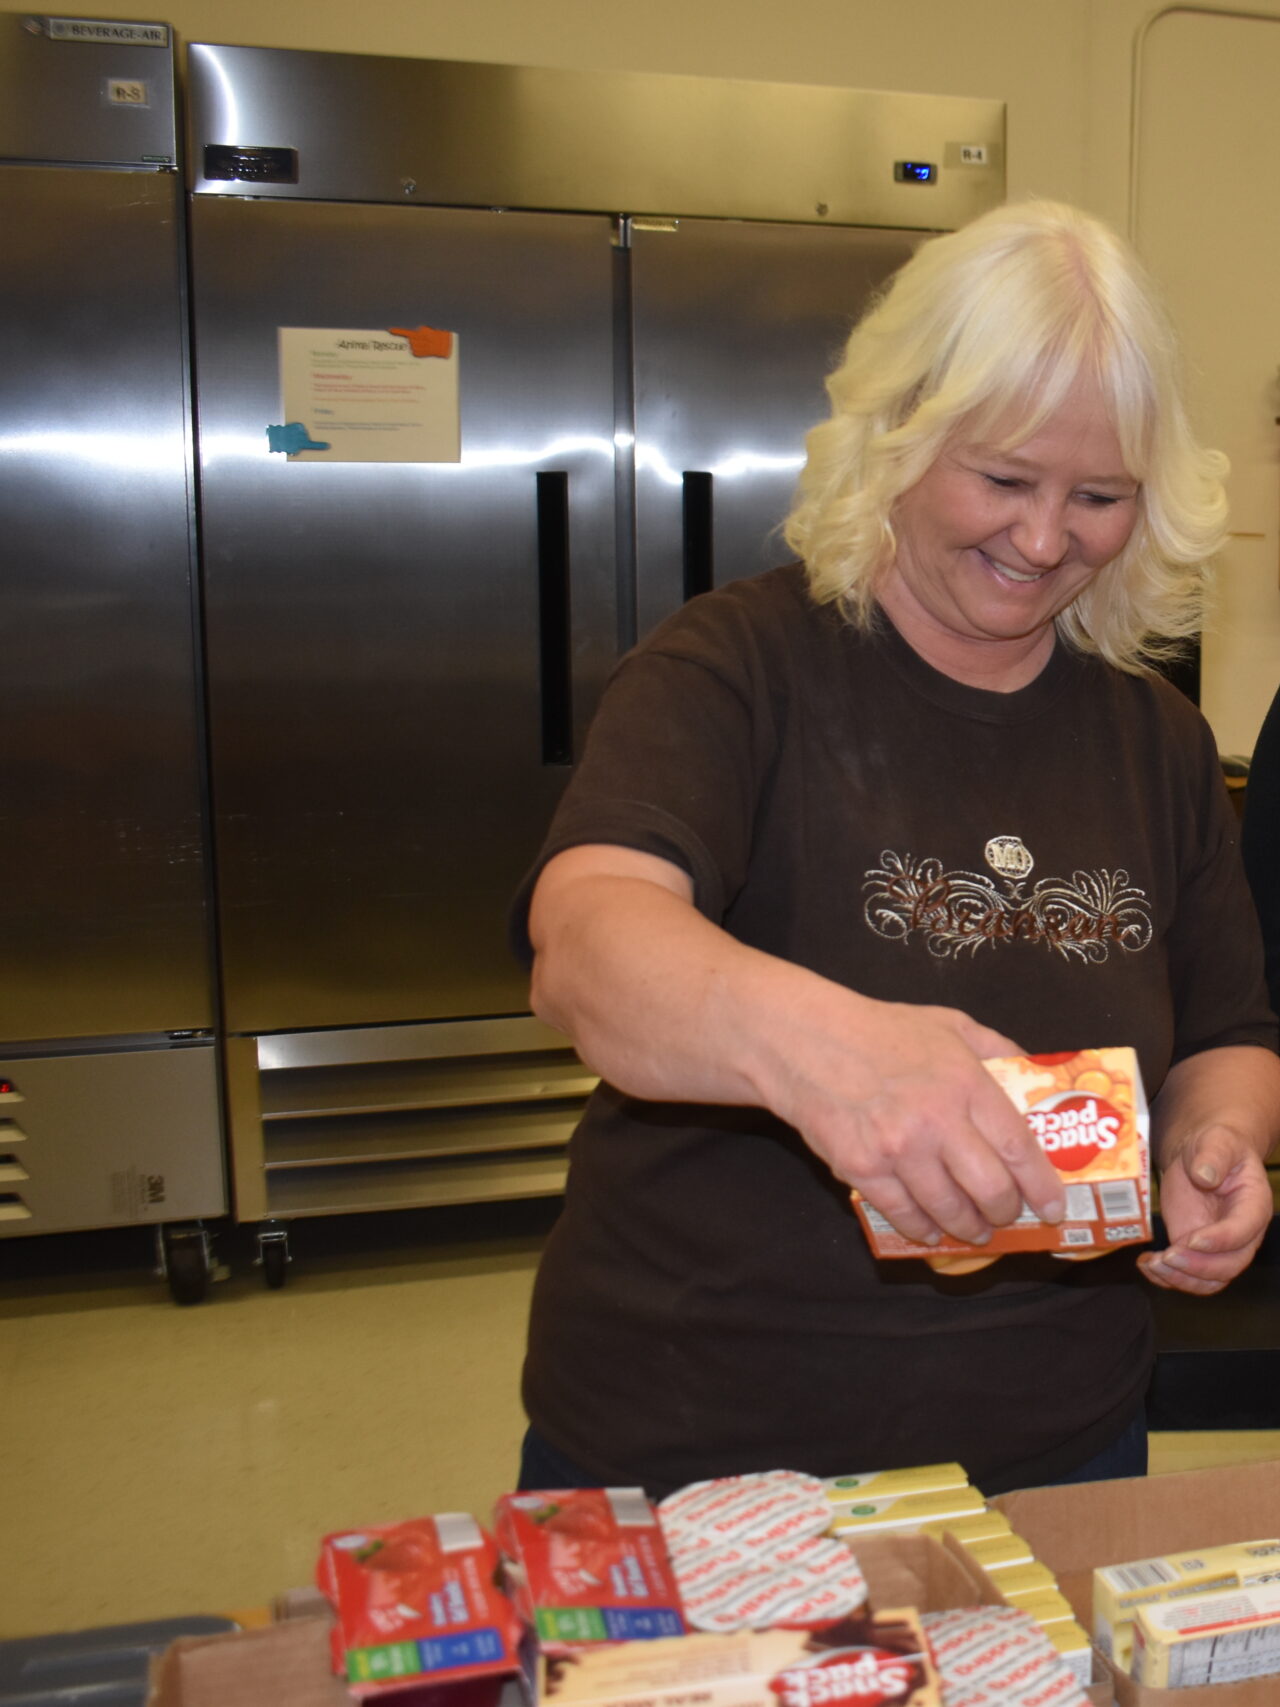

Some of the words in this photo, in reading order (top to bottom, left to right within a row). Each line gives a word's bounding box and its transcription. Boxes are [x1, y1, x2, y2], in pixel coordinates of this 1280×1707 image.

[72, 25, 162, 41] BEVERAGE-AIR
[1028, 1099, 1098, 1132] pack
[1038, 1115, 1120, 1152] Snac
[782, 1651, 878, 1697] pack
